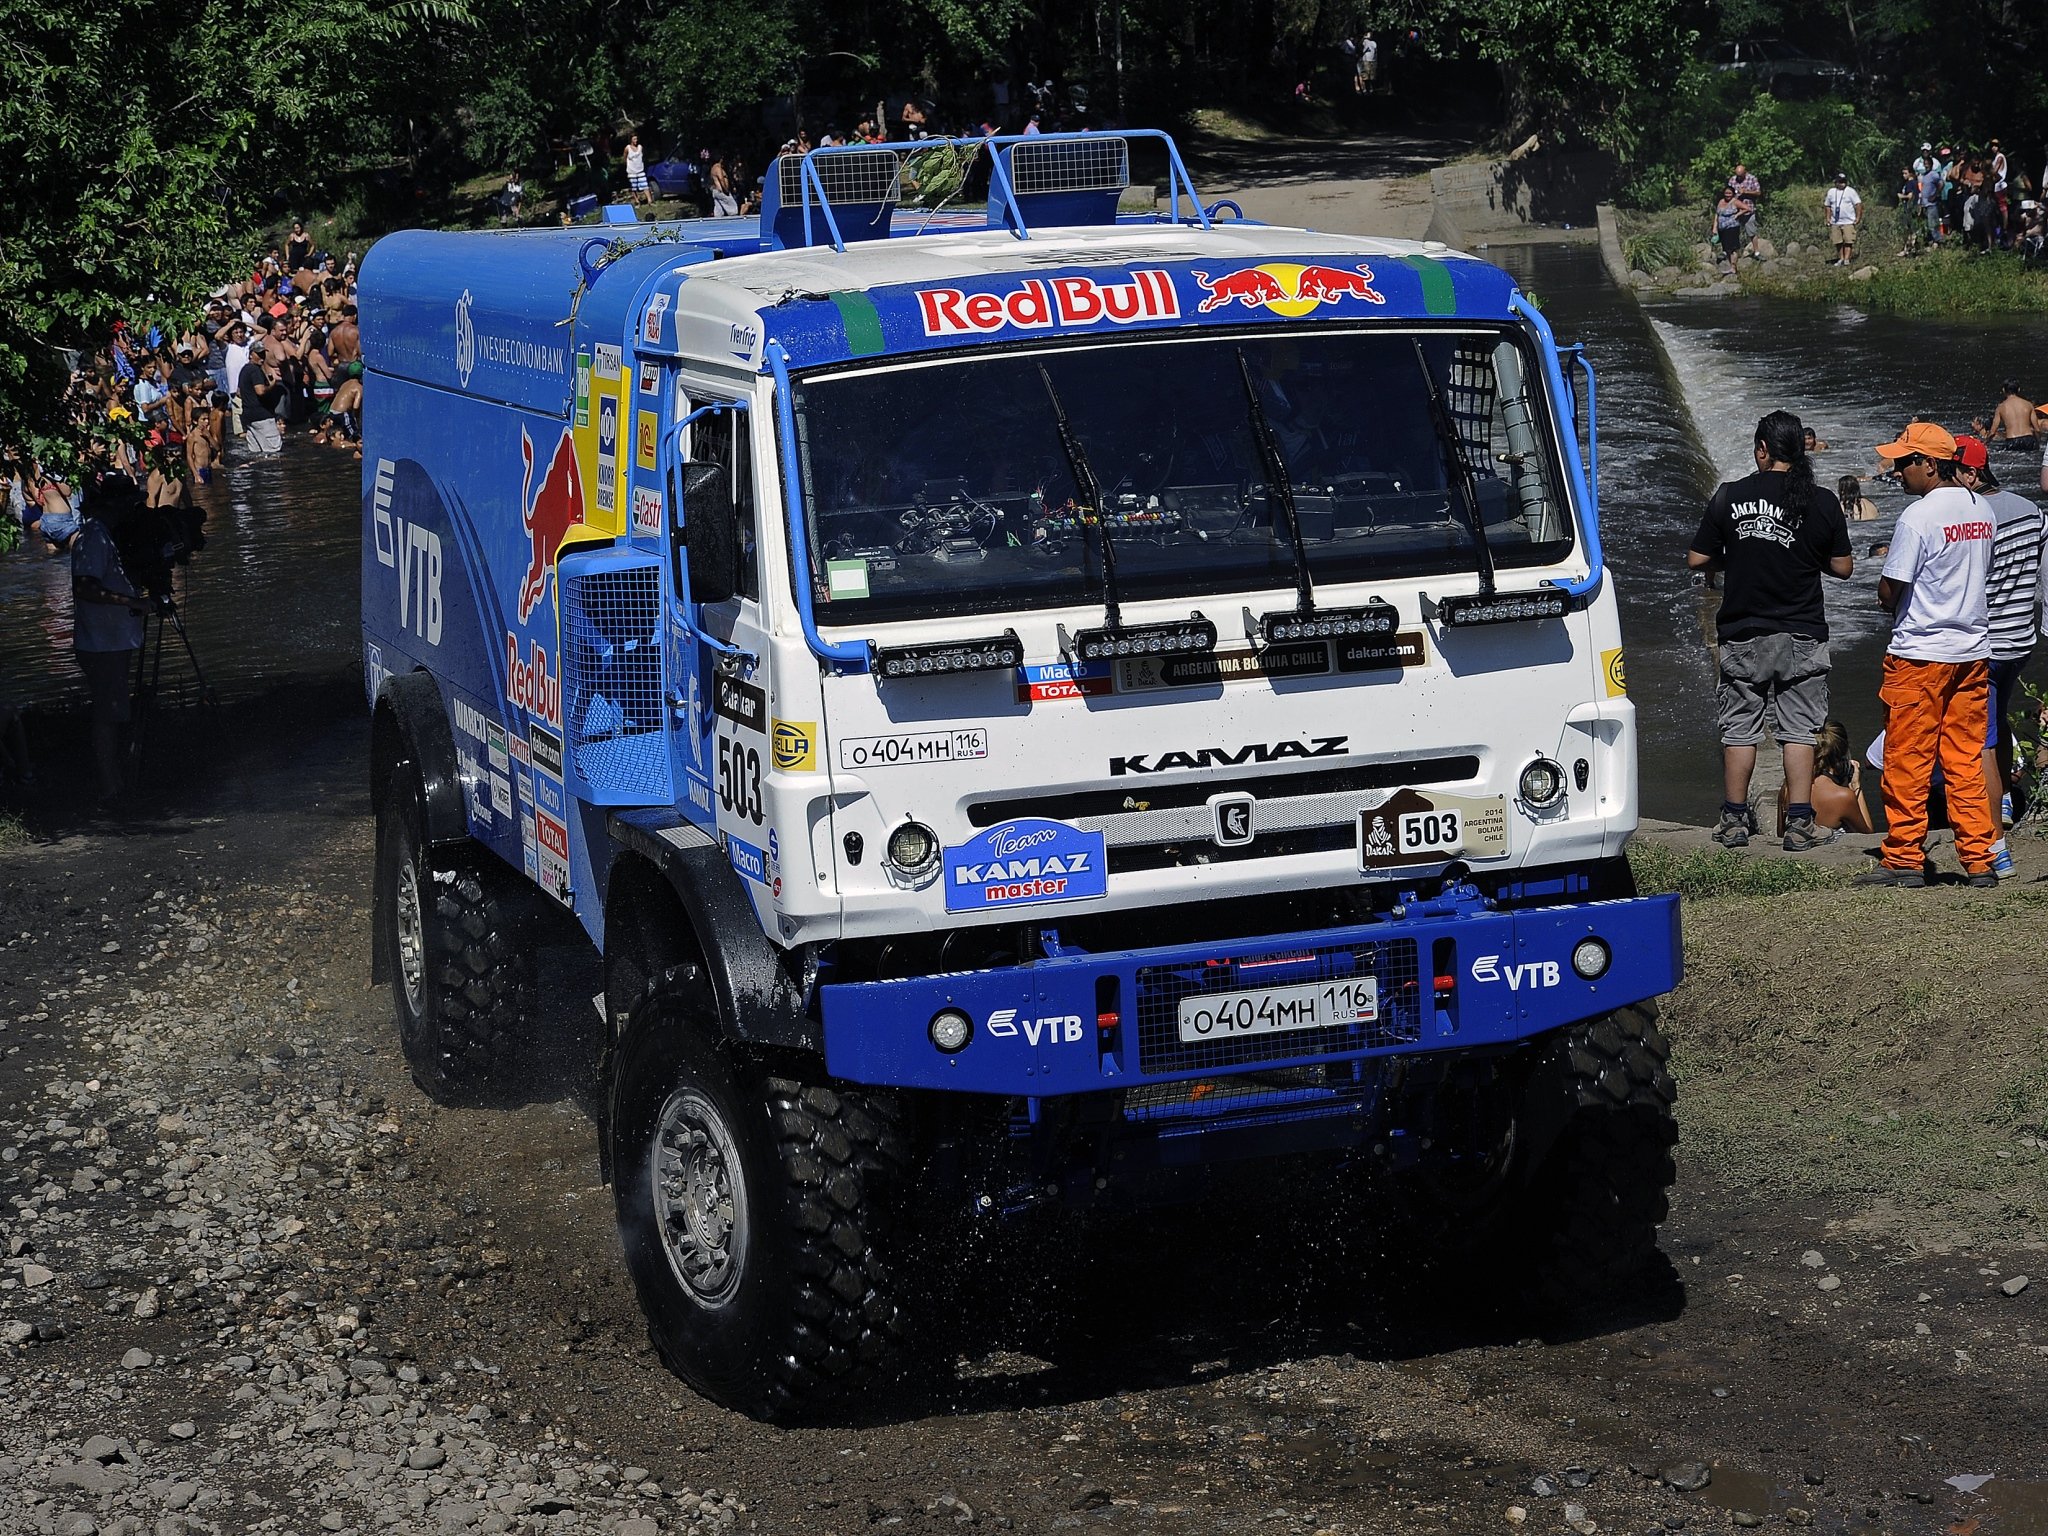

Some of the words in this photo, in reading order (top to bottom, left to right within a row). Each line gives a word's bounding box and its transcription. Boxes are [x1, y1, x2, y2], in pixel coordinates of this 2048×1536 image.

[917, 279, 1051, 334] Red
[1050, 270, 1179, 324] Bull
[478, 334, 564, 375] VNESHECONOMBANK
[1731, 501, 1758, 520] JACK
[1943, 522, 1992, 543] BOMBEROS
[397, 516, 442, 646] VTB
[1312, 613, 1352, 622] LAZER
[1126, 630, 1168, 639] LAZER
[929, 647, 972, 656] LAZER
[1173, 658, 1240, 677] ARGENTINA
[1243, 654, 1289, 671] BOLIVIA
[1292, 650, 1324, 667] CHILE
[1346, 644, 1416, 660] dakar.com
[507, 631, 536, 715] Red
[1039, 665, 1088, 681] Macro
[454, 697, 487, 744] WABCO
[955, 733, 980, 750] 116
[957, 750, 974, 758] RUS
[1108, 735, 1349, 777] KAMAZ
[719, 734, 764, 826] 503
[540, 777, 560, 812] Macro
[1463, 817, 1504, 828] ARGENTINA
[1484, 808, 1503, 817] 2014
[540, 816, 566, 856] TOTAL
[987, 825, 1057, 859] Team
[1405, 813, 1458, 848] 503
[1477, 826, 1504, 835] BOLIVIA
[1484, 834, 1504, 842] CHILE
[731, 841, 760, 875] Macro
[1365, 842, 1395, 857] DAKAR
[955, 851, 1091, 885] KAMAZ
[985, 877, 1068, 901] master
[1503, 960, 1561, 991] VTB
[1323, 983, 1368, 1010] 116
[1332, 1009, 1357, 1021] RUS
[1021, 1014, 1083, 1046] VTB
